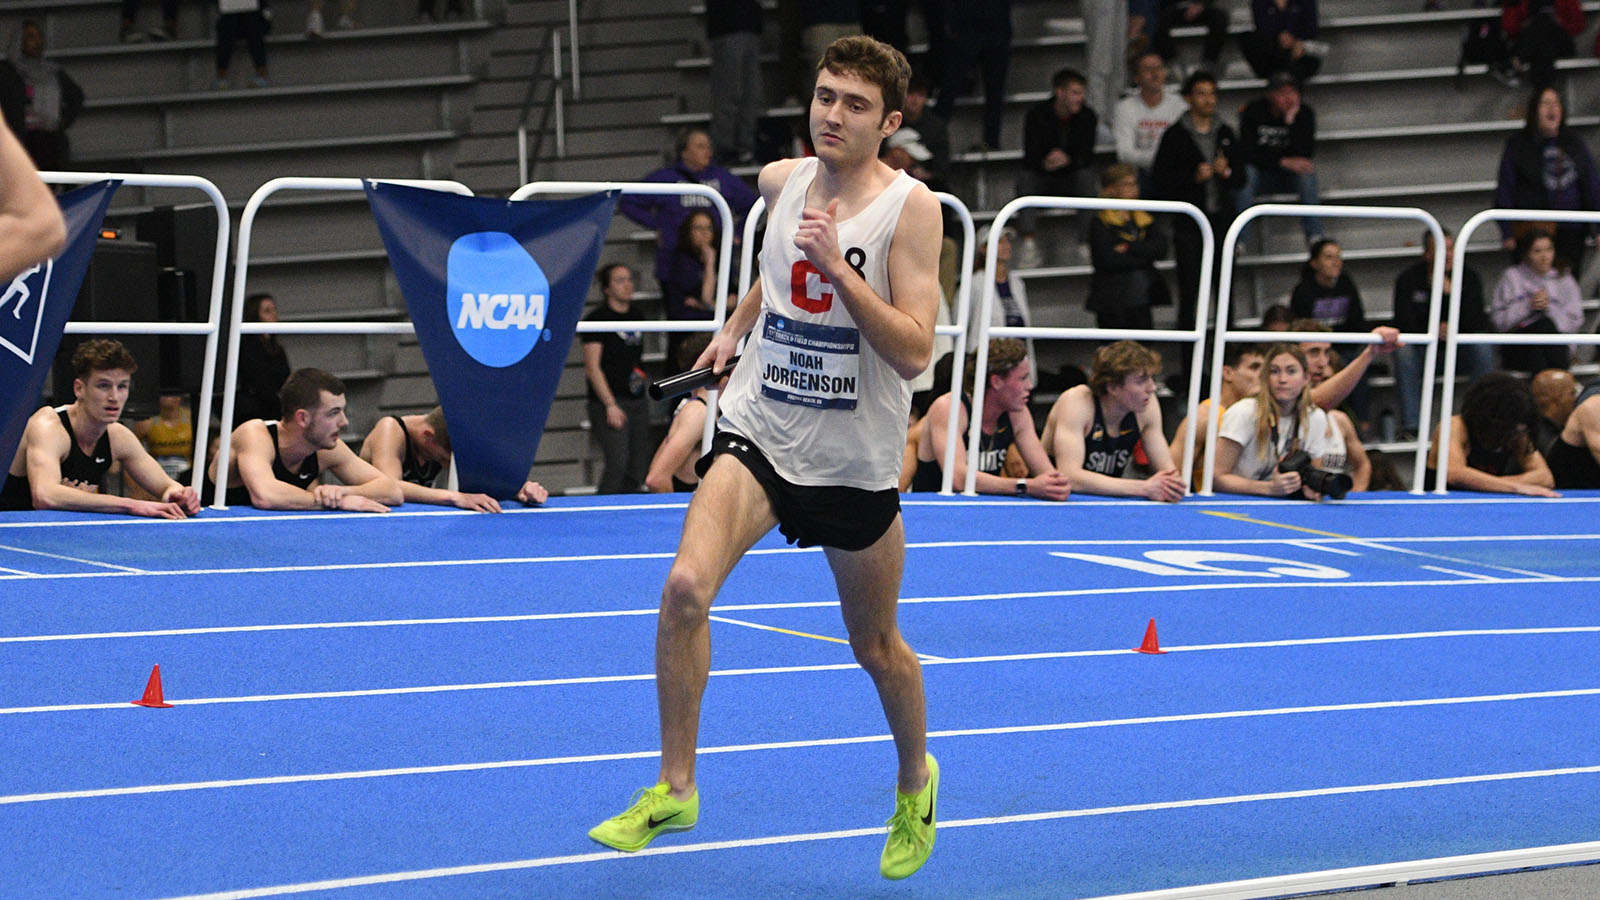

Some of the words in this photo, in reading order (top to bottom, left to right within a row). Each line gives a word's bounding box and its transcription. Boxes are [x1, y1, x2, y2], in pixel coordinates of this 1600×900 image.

[791, 260, 834, 314] C
[457, 293, 545, 330] NCAA
[789, 351, 823, 370] NOAH
[763, 363, 856, 394] JORGENSON
